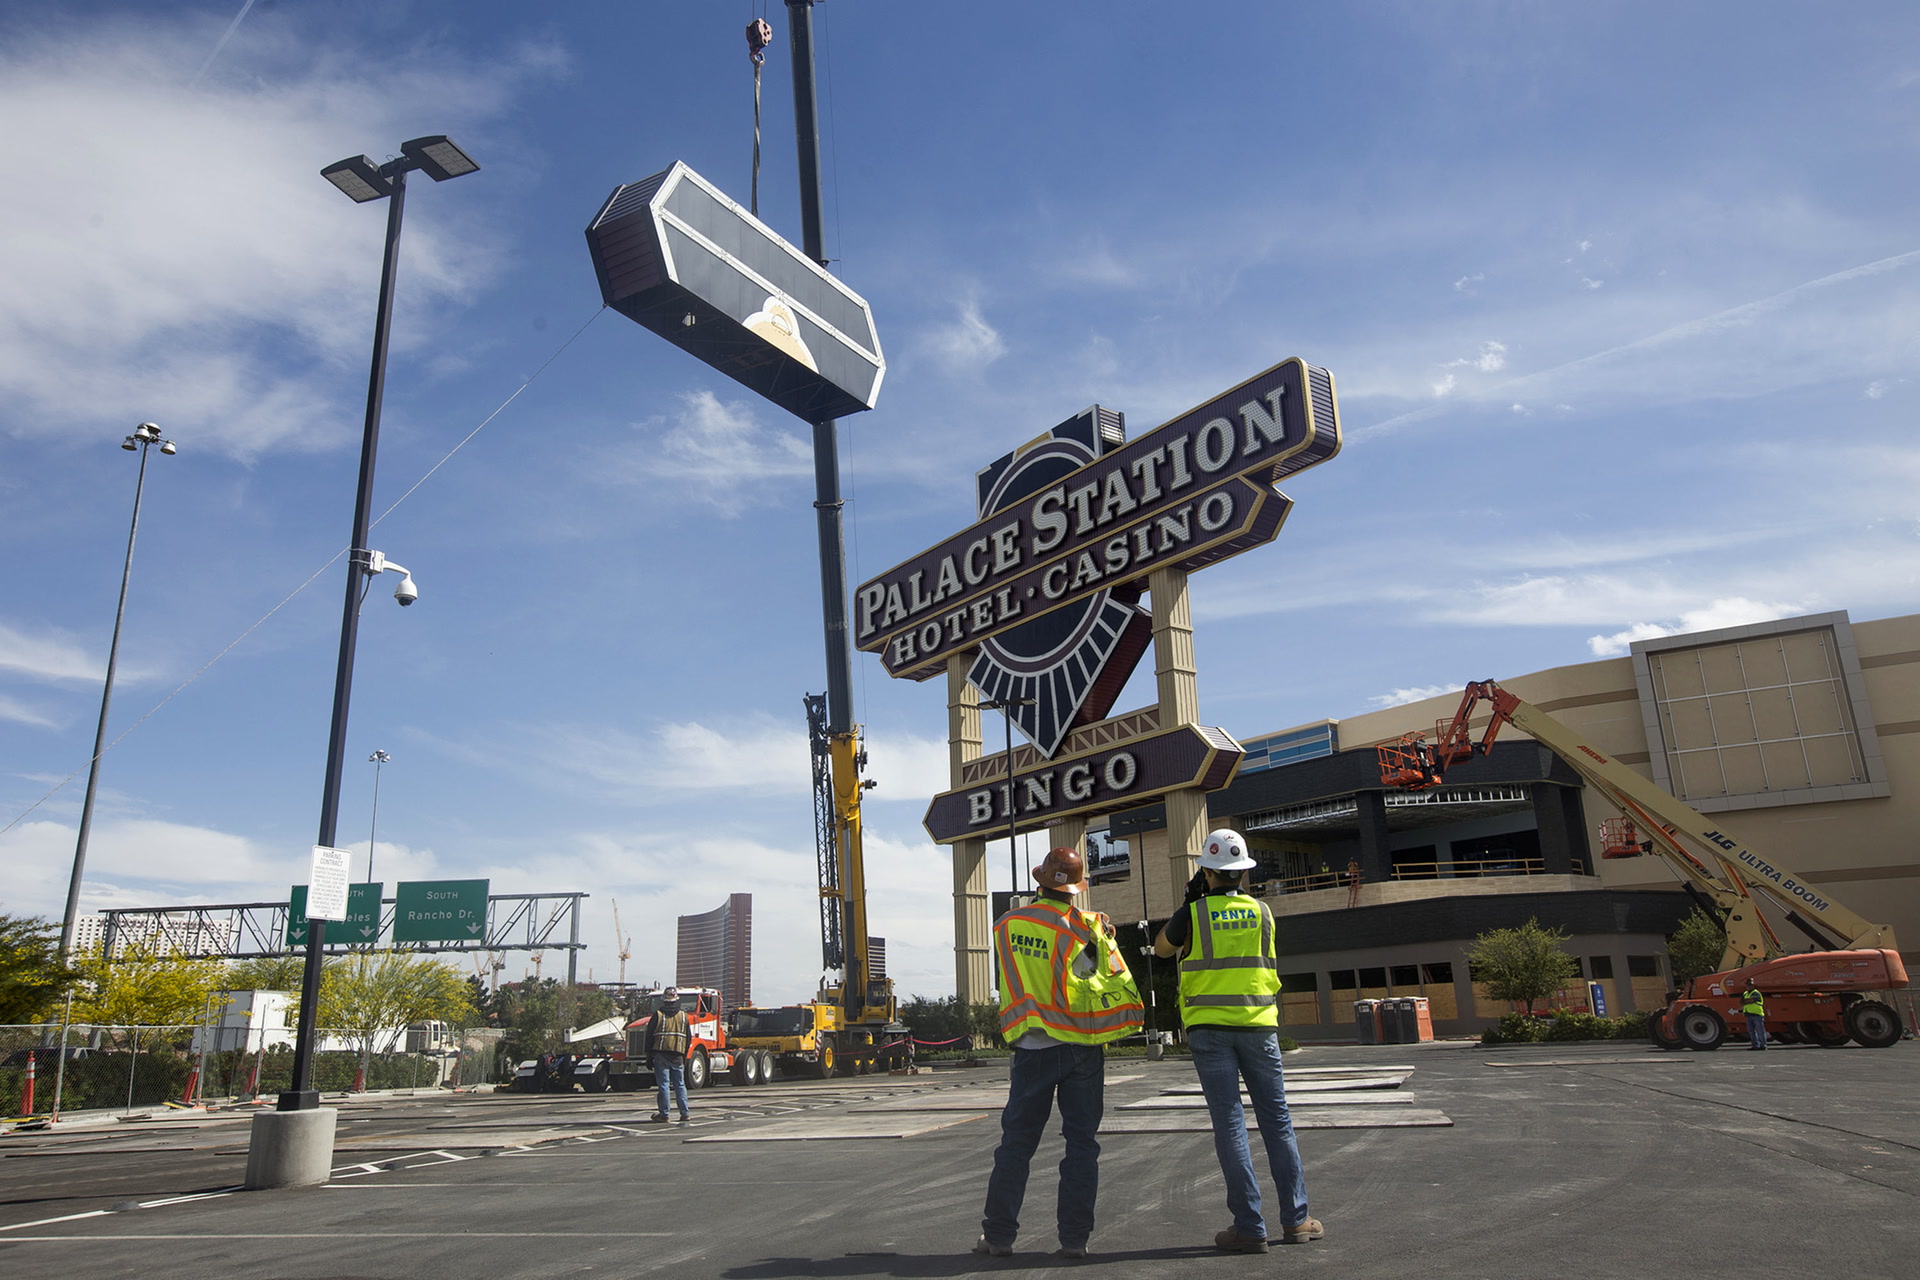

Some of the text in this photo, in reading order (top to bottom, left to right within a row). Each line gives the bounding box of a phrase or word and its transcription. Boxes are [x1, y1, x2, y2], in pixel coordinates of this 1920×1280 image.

[858, 383, 1286, 639] PALACE STATION
[892, 490, 1234, 667] HOTEL CASINO
[967, 752, 1137, 826] BINGO
[1703, 831, 1737, 851] JLG
[1738, 850, 1783, 882] ULTRA
[1782, 879, 1831, 912] BOOM
[348, 889, 364, 898] UTH
[426, 891, 459, 900] SOUTH
[408, 908, 475, 920] Rancho Dr.
[1210, 908, 1257, 922] PENTA
[1011, 933, 1048, 951] PENTA
